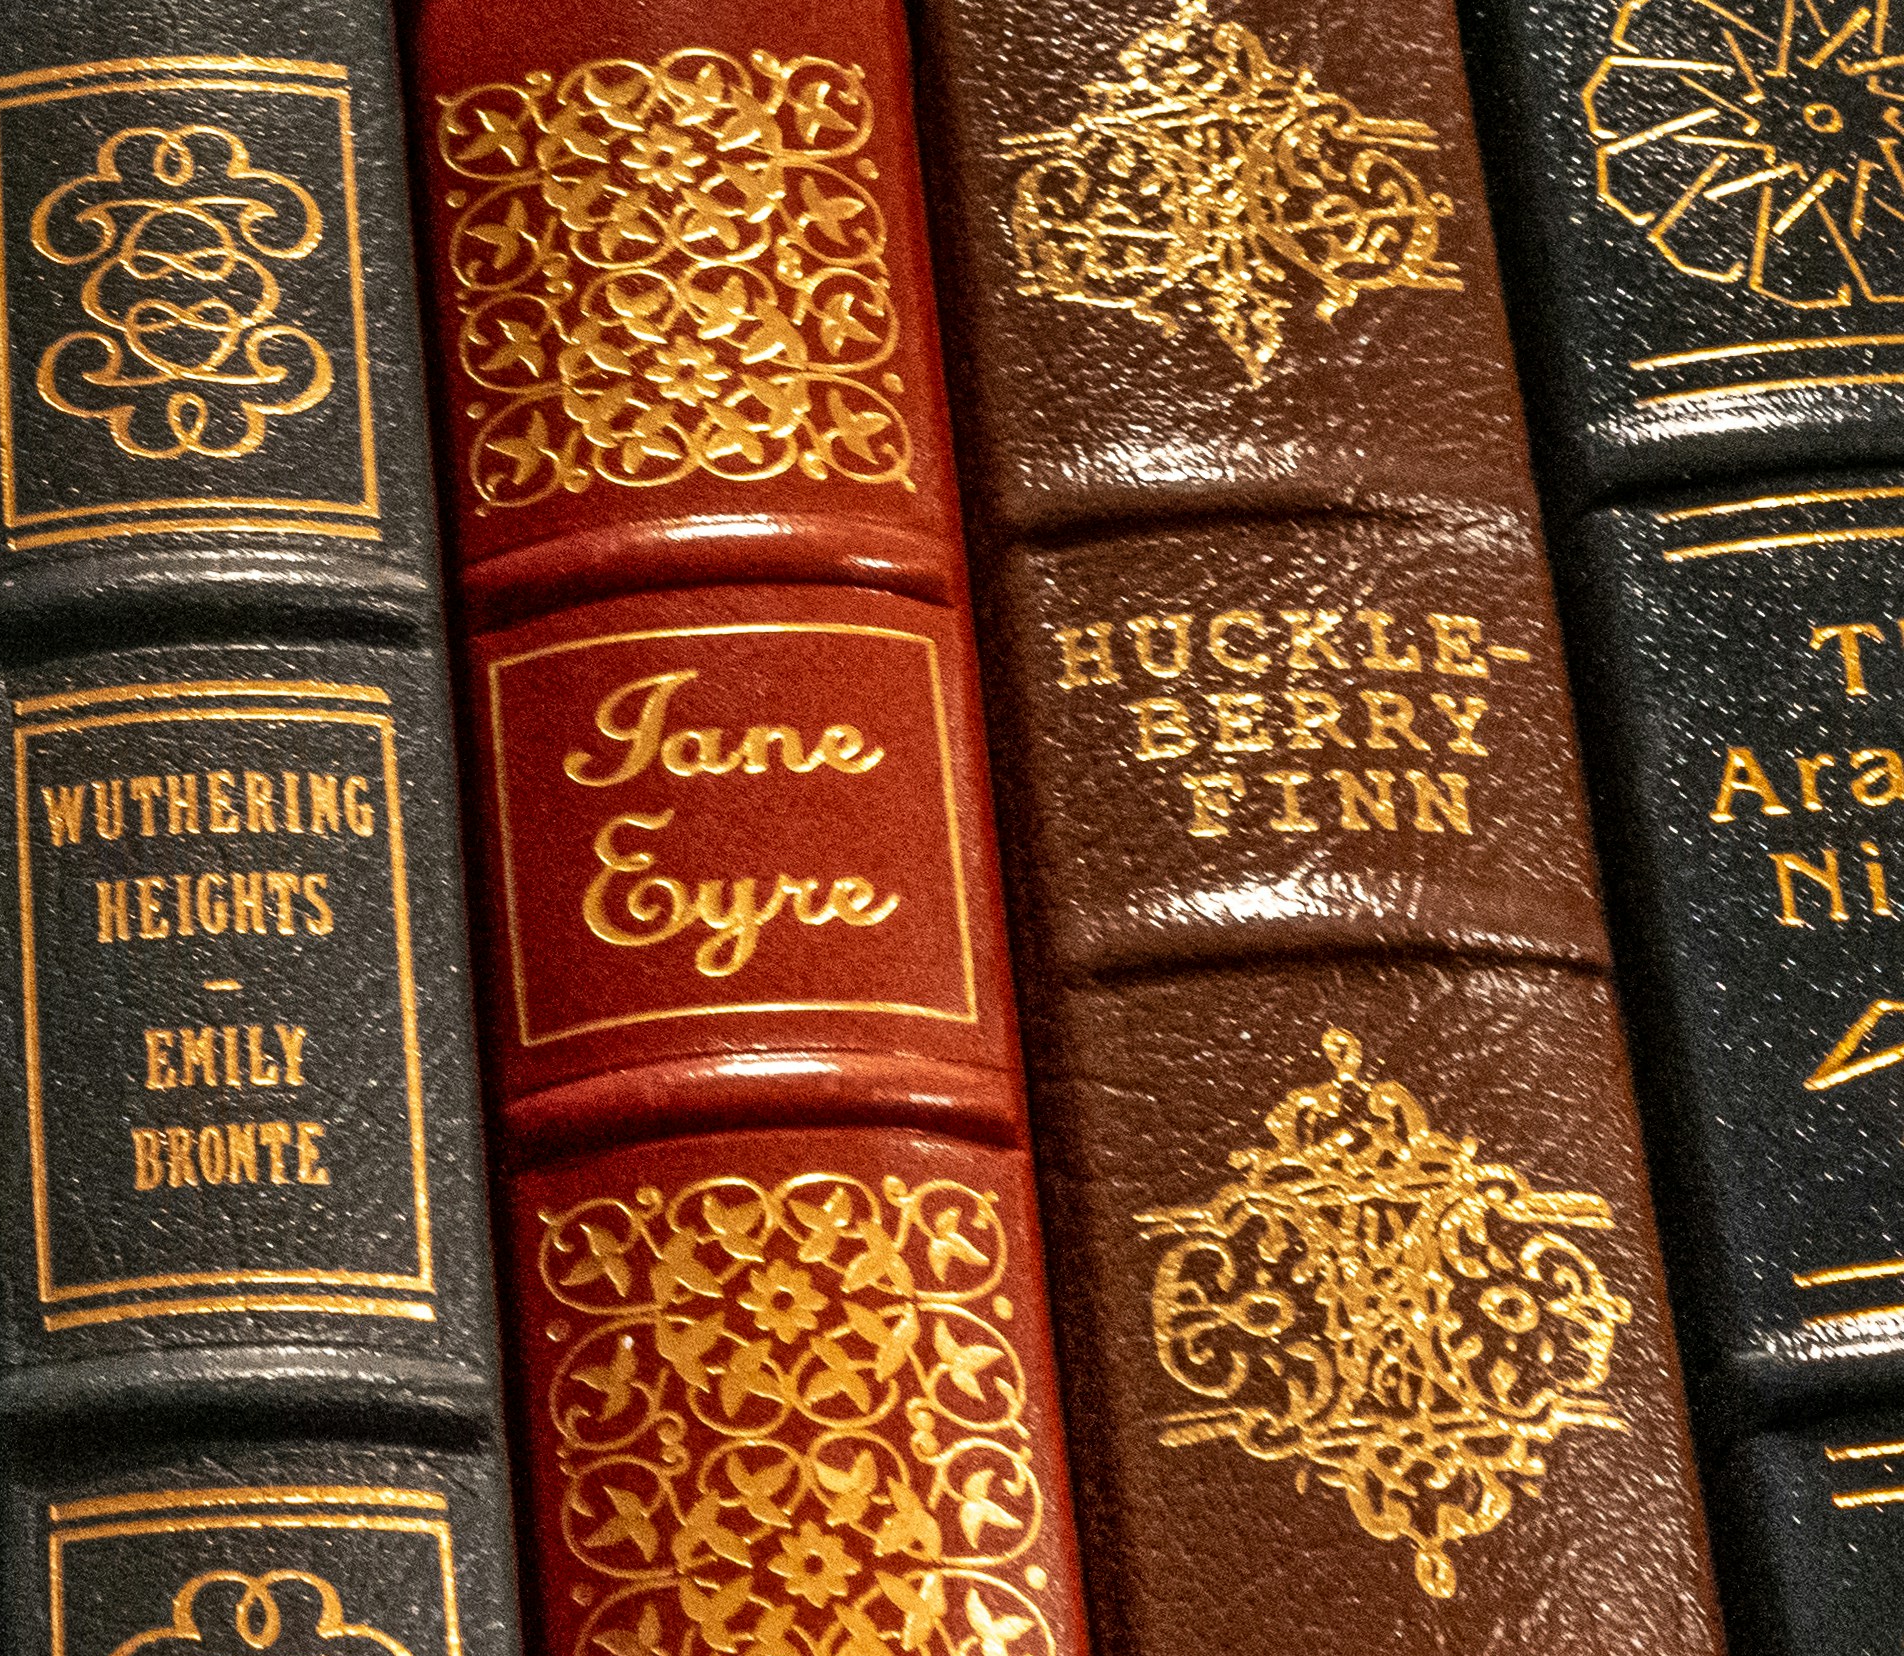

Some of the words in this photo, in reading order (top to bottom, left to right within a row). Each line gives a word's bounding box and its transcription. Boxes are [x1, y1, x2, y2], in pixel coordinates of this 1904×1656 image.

[1053, 608, 1532, 691] HUCKLE-
[1808, 618, 1904, 698] T
[563, 668, 886, 788] Jane
[1128, 689, 1490, 761] BERRY
[40, 769, 375, 848] WUTHERING
[1181, 768, 1475, 838] FINN
[96, 872, 335, 944] HEIGHTS
[582, 808, 902, 978] Eyre
[143, 1023, 309, 1092] EMILY
[130, 1120, 332, 1191] BRONTE
